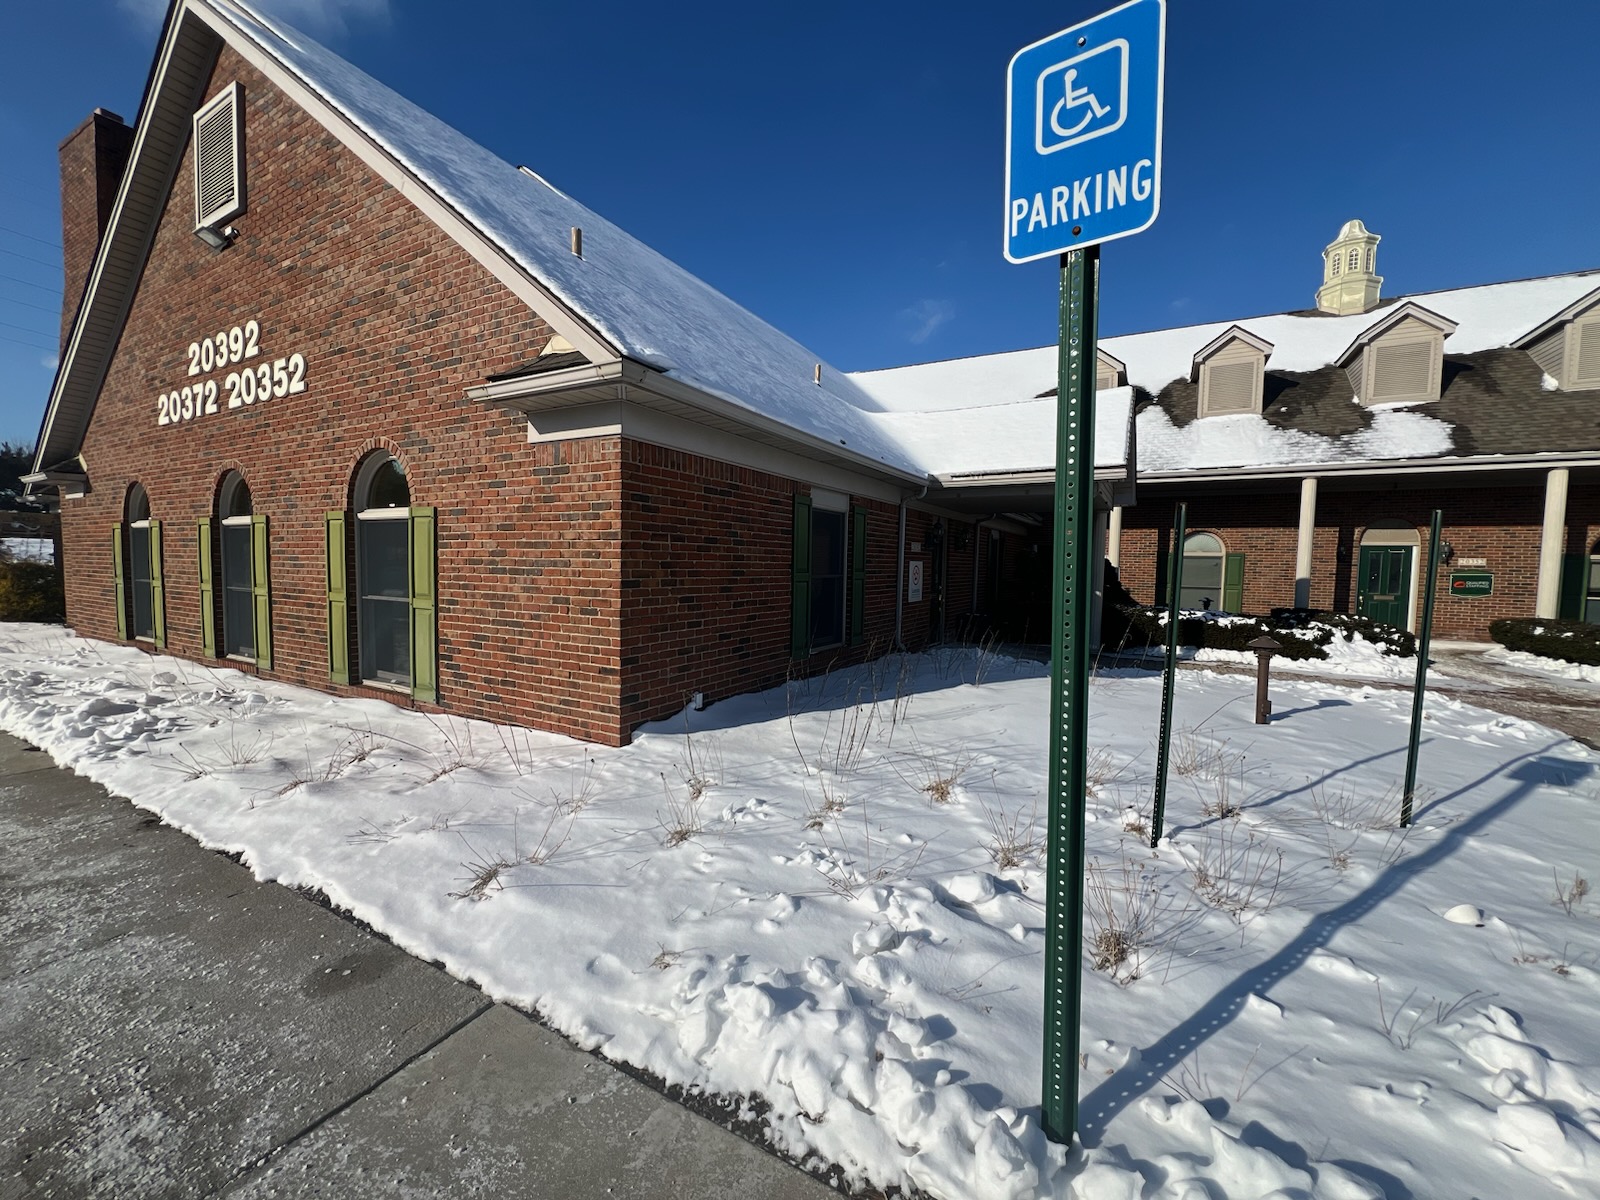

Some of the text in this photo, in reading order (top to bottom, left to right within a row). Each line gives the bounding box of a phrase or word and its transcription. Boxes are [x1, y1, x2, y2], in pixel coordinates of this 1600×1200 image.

[1011, 158, 1152, 237] PARKING
[187, 319, 260, 377] 20392
[157, 352, 306, 426] 20372 20352
